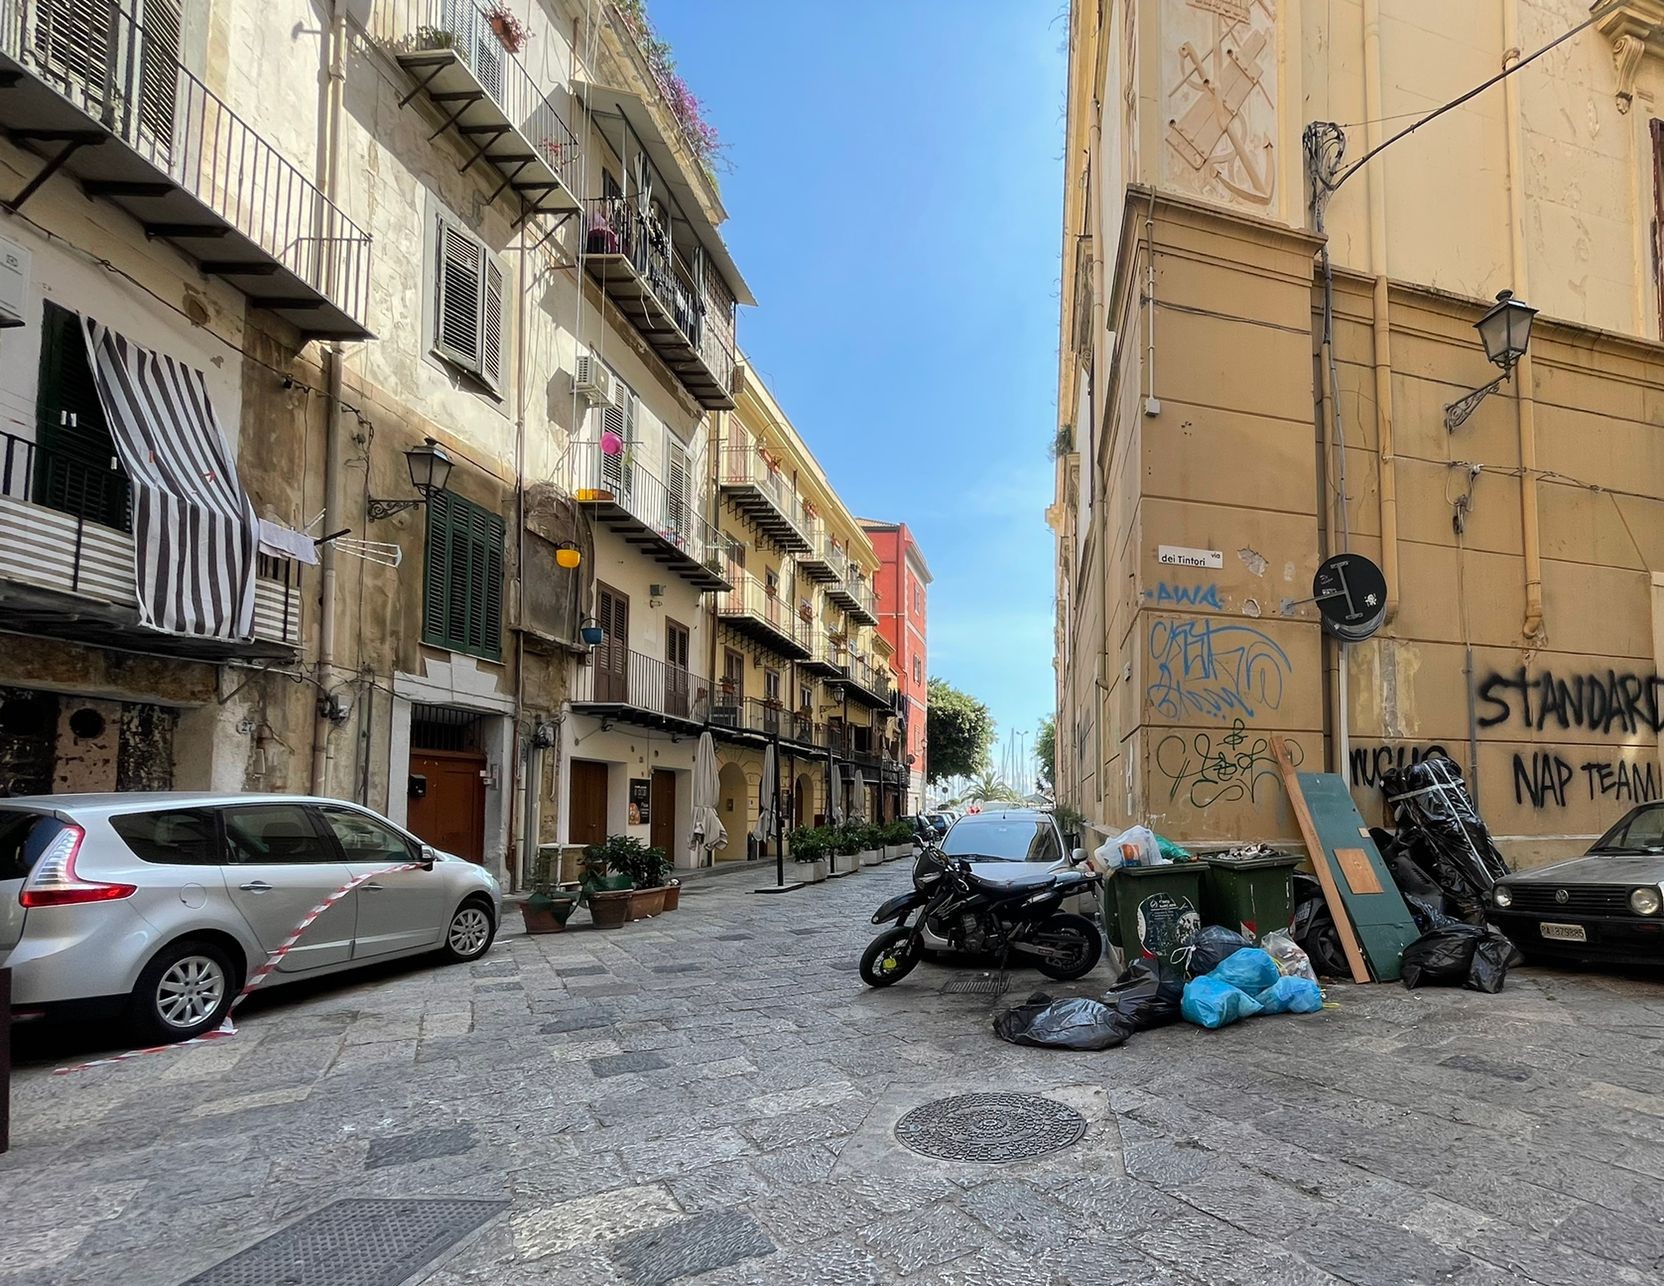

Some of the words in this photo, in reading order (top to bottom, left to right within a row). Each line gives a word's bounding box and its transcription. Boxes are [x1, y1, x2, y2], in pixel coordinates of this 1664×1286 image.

[1161, 554, 1176, 563] dei
[1177, 555, 1206, 566] Tintori
[1512, 752, 1573, 807] NAP
